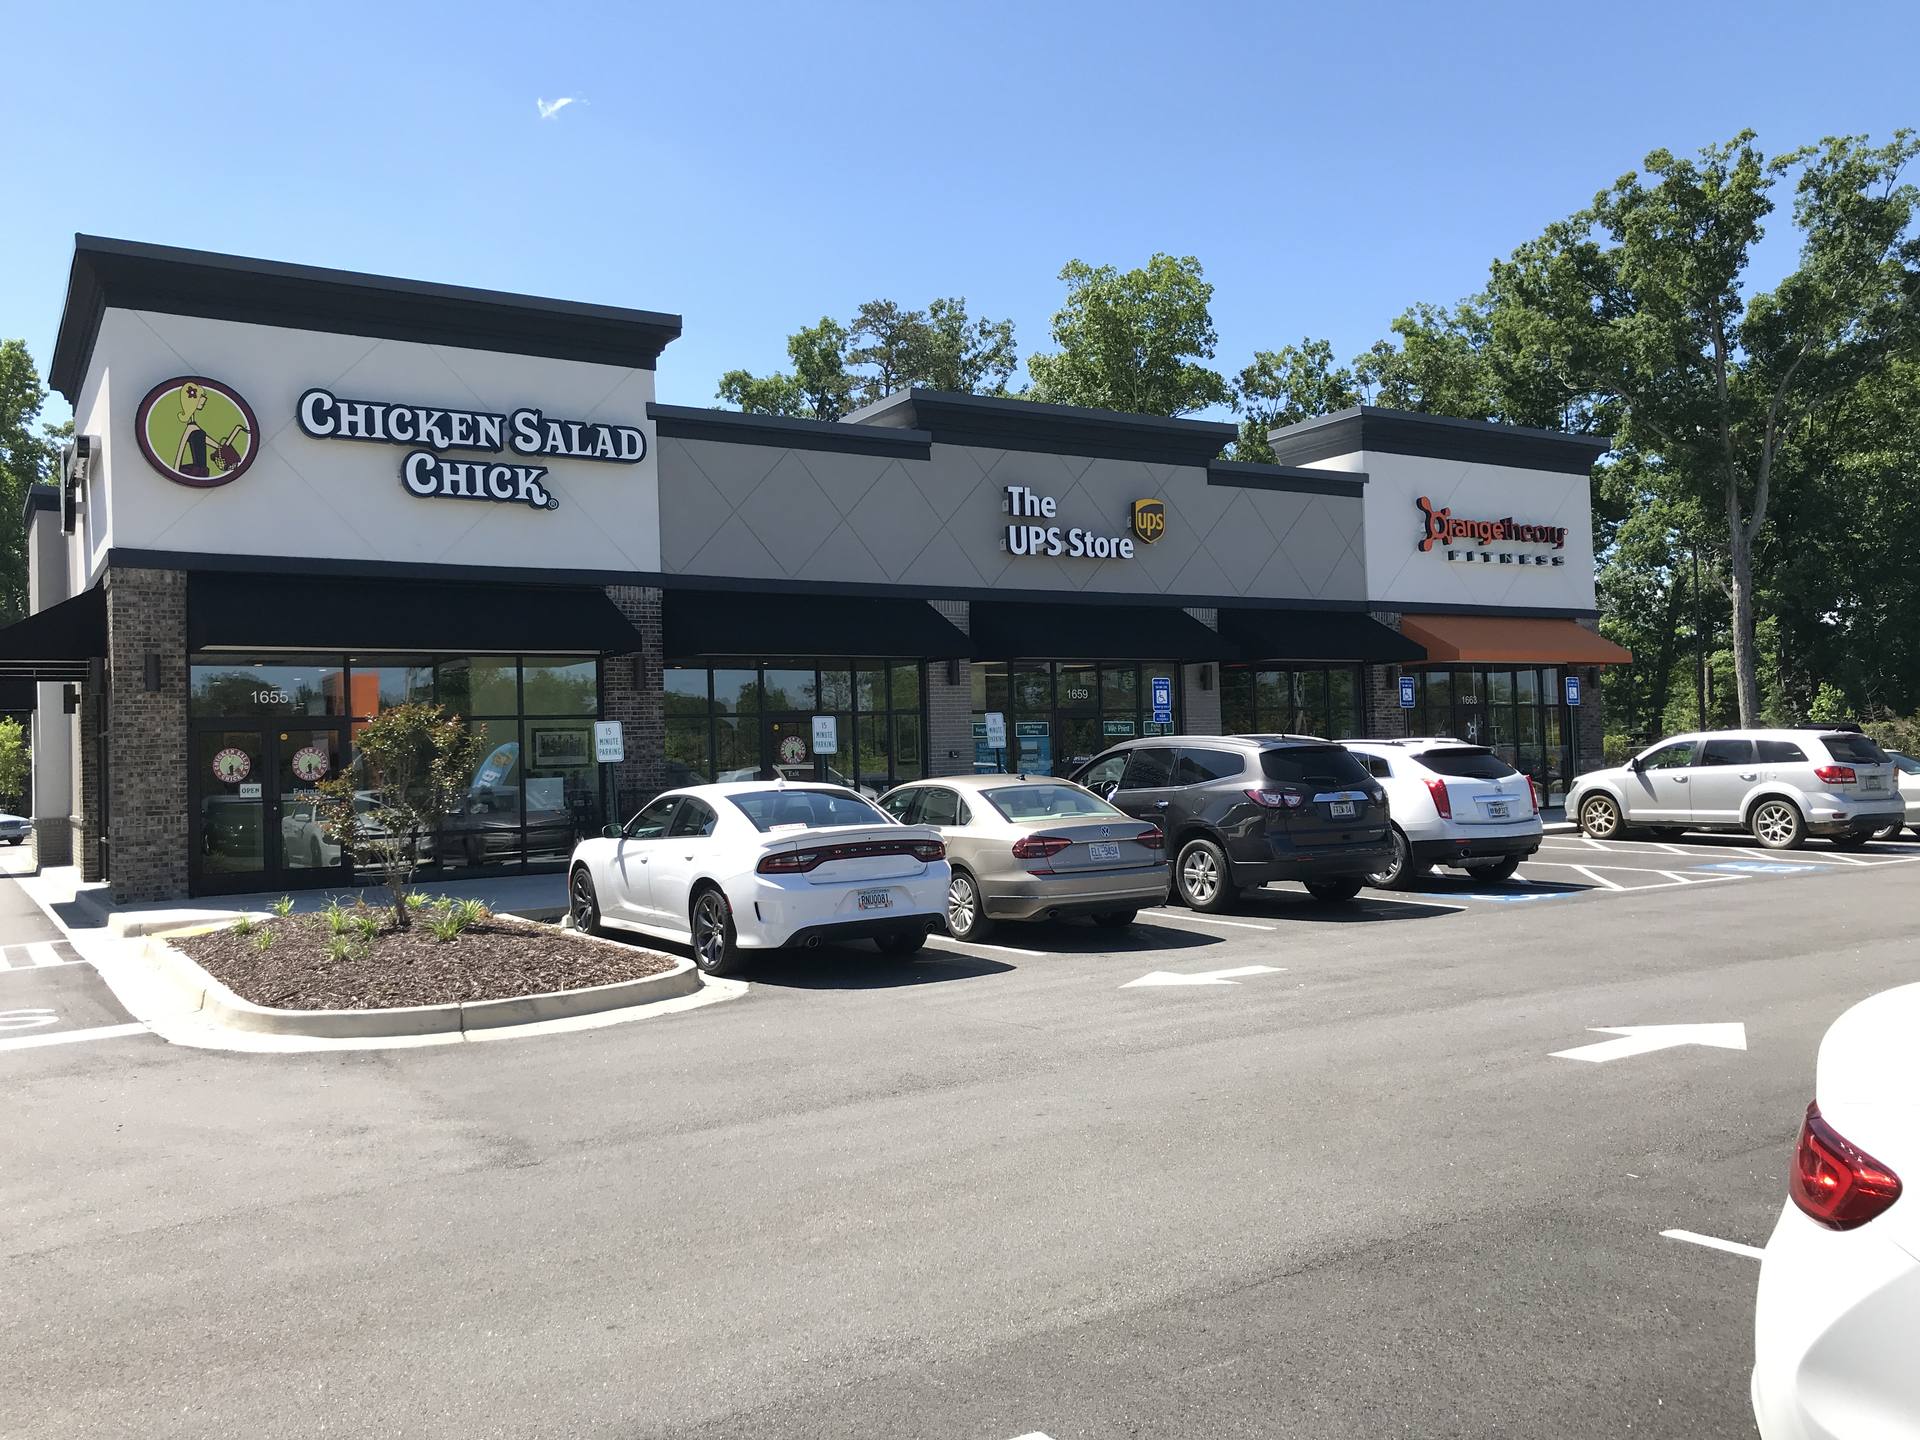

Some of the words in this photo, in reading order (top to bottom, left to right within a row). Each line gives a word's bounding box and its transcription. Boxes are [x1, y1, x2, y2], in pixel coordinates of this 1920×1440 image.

[300, 391, 505, 452] CHICKEN
[512, 410, 645, 461] SALAD
[1006, 485, 1057, 518] The
[1137, 511, 1164, 536] ups
[1008, 525, 1063, 556] UPS
[1068, 528, 1134, 559] Store
[1448, 550, 1566, 567] FITNESS
[250, 690, 289, 704] 1655
[1066, 689, 1089, 700] 1659
[1462, 695, 1478, 705] 1663
[821, 721, 828, 730] 15
[605, 727, 612, 736] 15
[815, 731, 833, 739] MINUTE
[599, 737, 619, 746] MINUTE
[815, 740, 836, 749] PARKING
